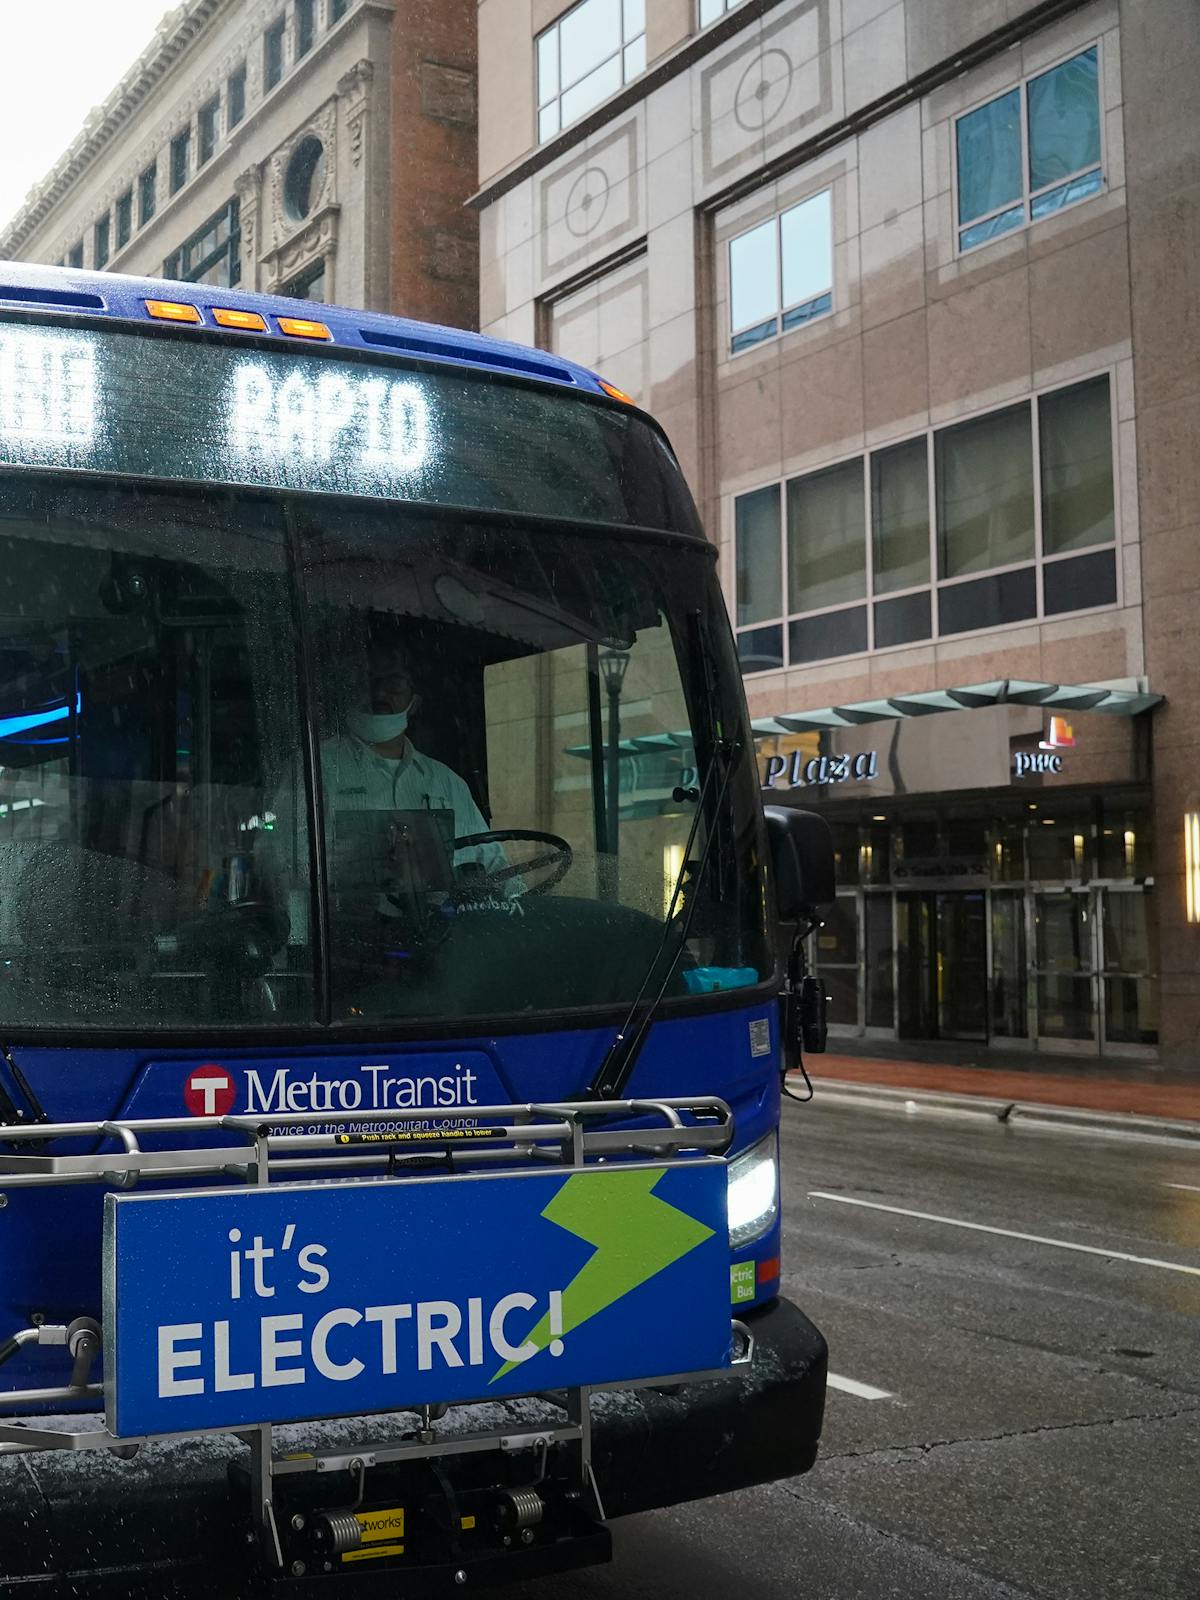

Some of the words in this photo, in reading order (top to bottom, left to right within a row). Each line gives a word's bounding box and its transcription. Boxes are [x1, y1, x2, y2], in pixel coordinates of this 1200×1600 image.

[232, 364, 428, 467] RAPID
[761, 749, 880, 790] Plaza
[1015, 751, 1063, 778] pwc
[268, 1125, 305, 1137] ervice
[307, 1124, 322, 1135] of
[325, 1122, 349, 1134] the
[349, 1119, 430, 1133] Metropolitan
[432, 1117, 479, 1130] Council
[361, 1133, 380, 1142] Push
[381, 1132, 397, 1141] rack
[397, 1131, 412, 1140] and
[412, 1130, 441, 1140] squeeze
[441, 1128, 465, 1138] handle
[464, 1128, 474, 1137] to
[473, 1127, 493, 1137] lower
[228, 1223, 331, 1299] it's
[737, 1284, 753, 1299] Bus
[157, 1289, 566, 1399] ELECTRIC!
